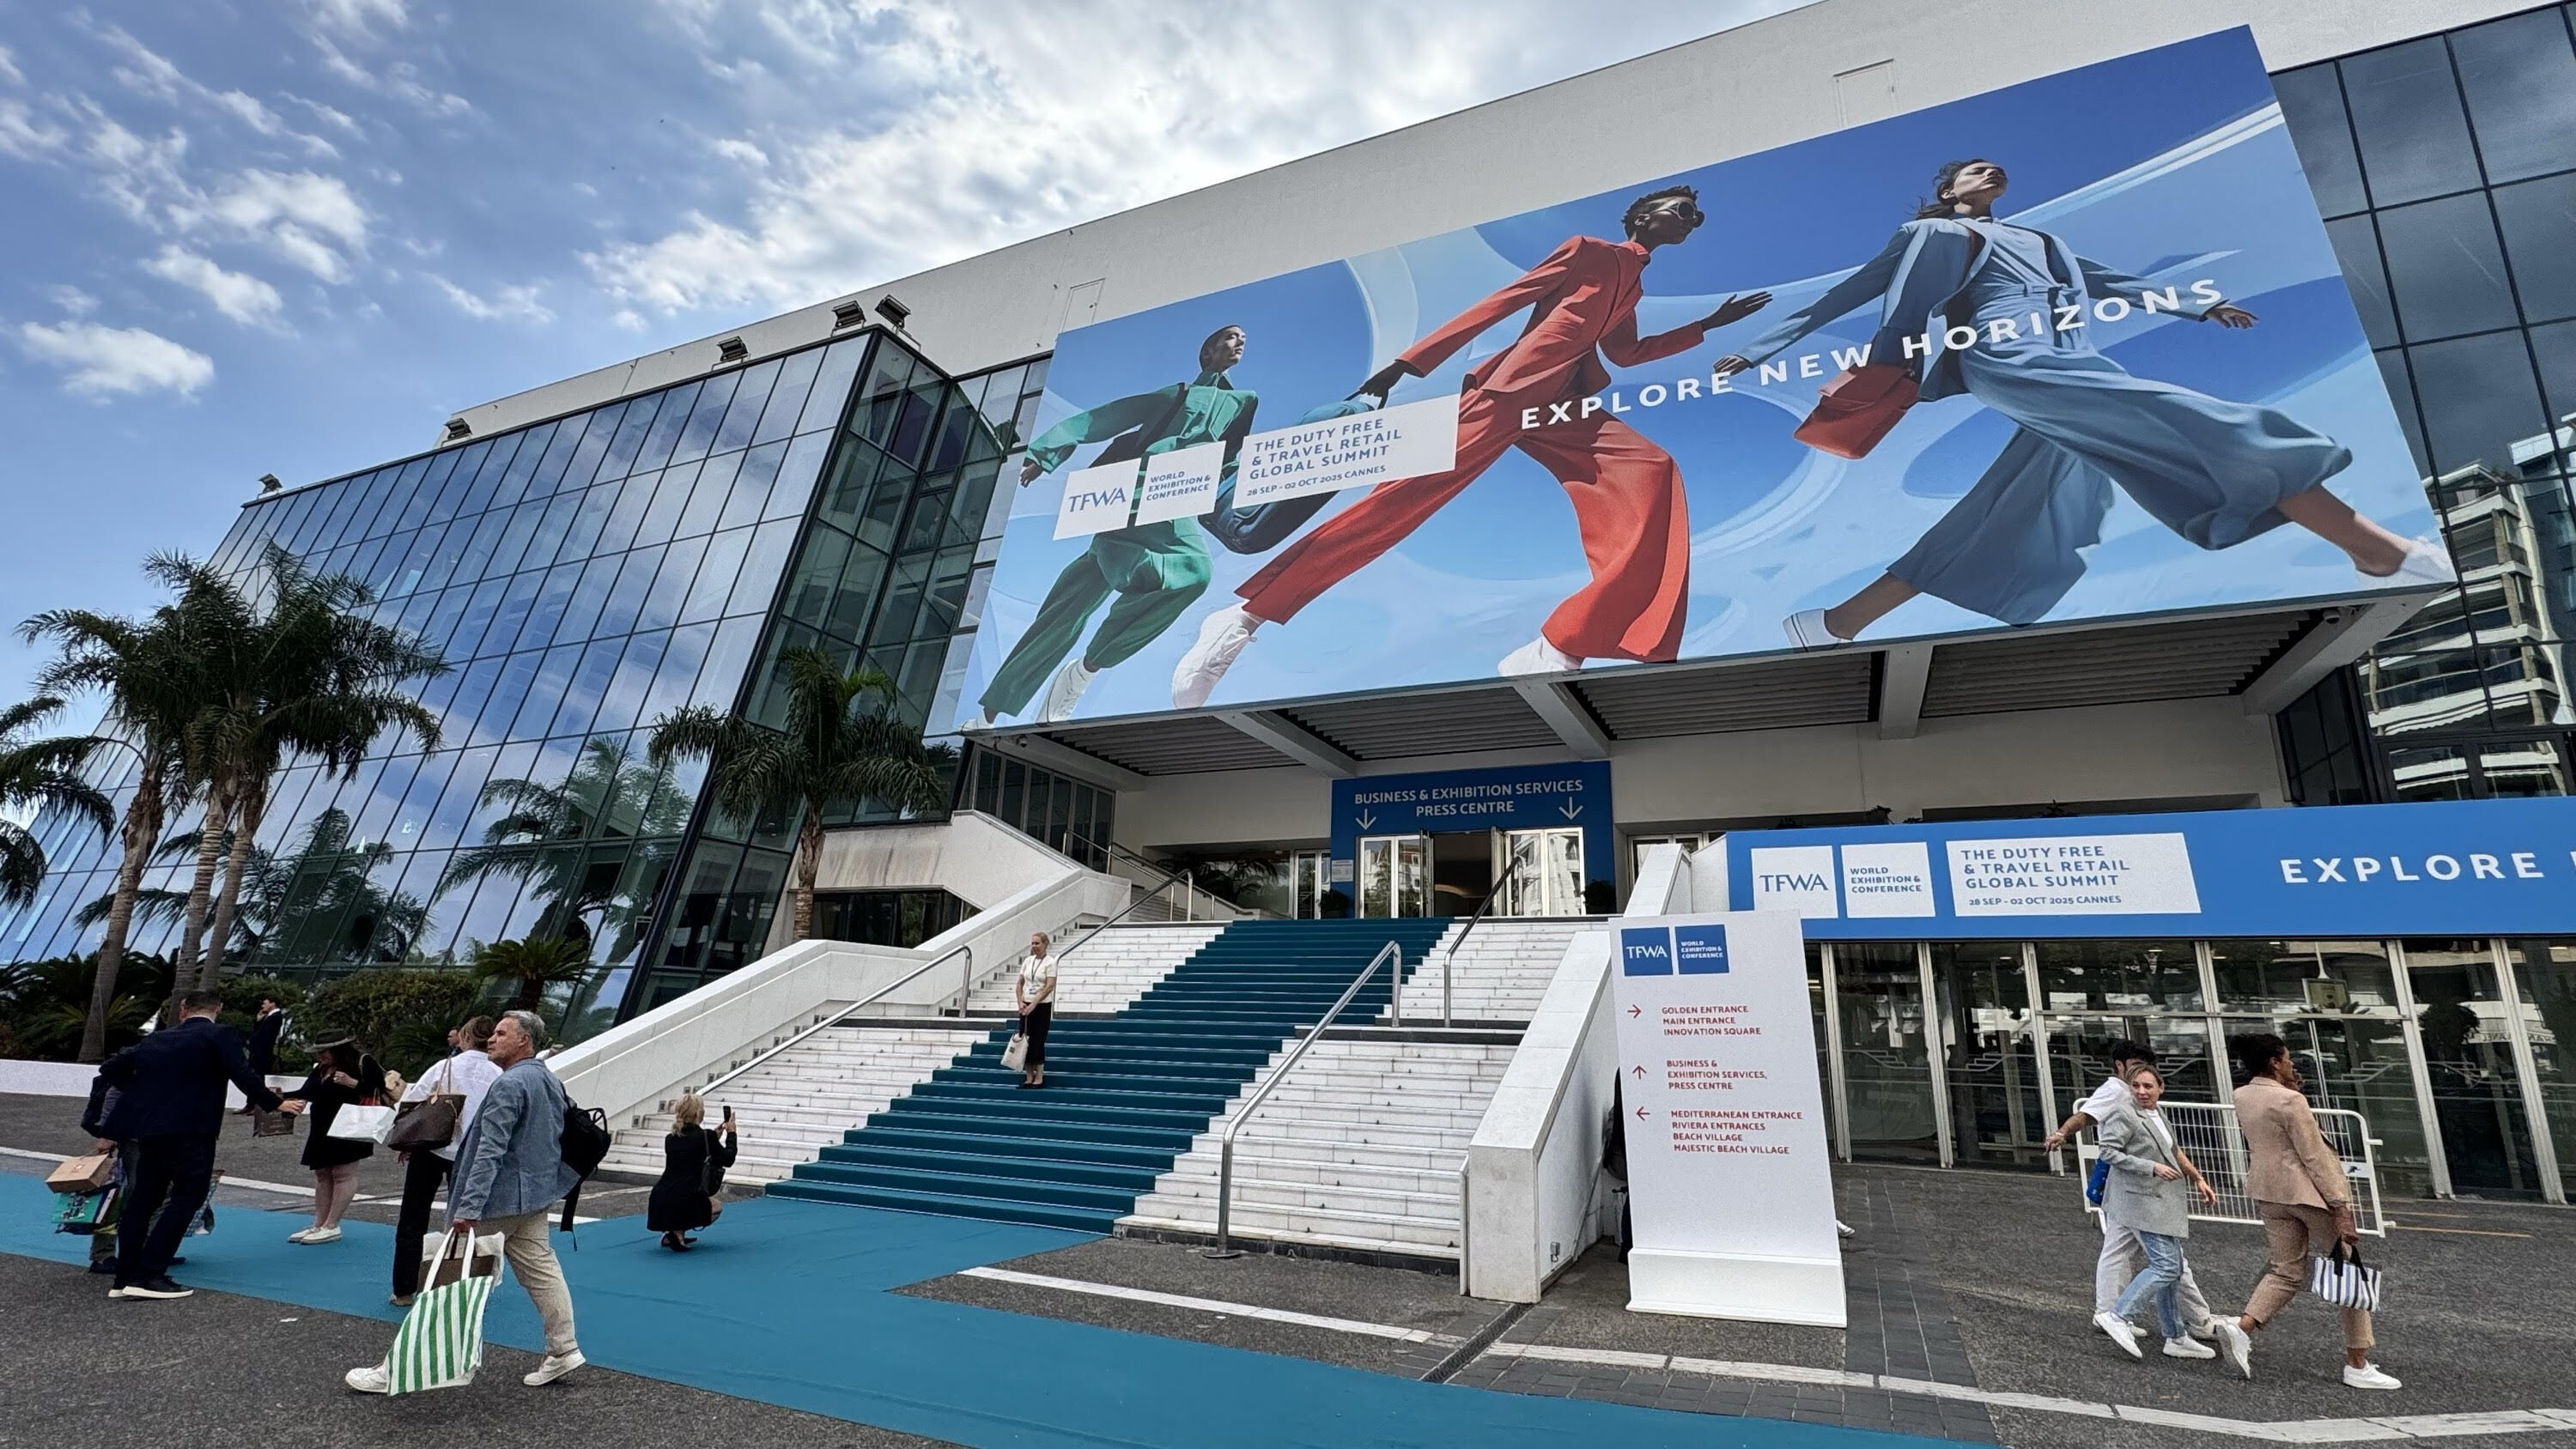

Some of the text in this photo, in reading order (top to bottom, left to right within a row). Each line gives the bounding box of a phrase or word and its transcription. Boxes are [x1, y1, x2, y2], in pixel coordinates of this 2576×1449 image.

[1522, 279, 2221, 429] EXPLORE NEW HORIZONS
[1255, 418, 1383, 452] THE DUTY FREE
[1252, 429, 1402, 466] & TRAVEL RETAIL
[1249, 445, 1389, 480] GLOBAL SUMMIT
[1151, 470, 1185, 483] WORLD
[1260, 485, 1277, 494] SEP
[1298, 477, 1318, 487] OCT
[1320, 474, 1342, 483] 2025
[1344, 464, 1386, 479] CANNES
[1148, 476, 1203, 492] EXHIBITION
[1146, 483, 1209, 501] CONFERENCE
[1069, 488, 1126, 512] TFWA
[1354, 779, 1583, 804] BUSINESS & EXHIBITION SERVICES
[1416, 801, 1515, 816] PRESS CENTRE
[1961, 846, 2105, 860] THE DUTY FREE
[1964, 858, 2130, 875] & TRAVEL RETAIL
[2280, 852, 2545, 883] EXPLORE
[1759, 874, 1829, 894] TFWA
[1850, 875, 1912, 884] EXHIBITION
[1965, 874, 2119, 889] GLOBAL SUMMIT
[1851, 884, 1923, 894] CONFERENCE
[1982, 897, 2002, 906] SEP
[2025, 896, 2046, 905] OCT
[2049, 896, 2075, 905] 2025
[2076, 894, 2122, 905] CANNES
[1626, 945, 1668, 959] TFWA
[1662, 1005, 1748, 1015] GOLDEN ENTRANCE
[1663, 1017, 1685, 1026] MAIN
[1724, 1028, 1761, 1036] SQUARE
[1722, 1071, 1768, 1080] SERVICES,
[1698, 1082, 1733, 1090] CENTRE
[1671, 1110, 1802, 1119] MEDITERRANEAN ENTRANCE
[1710, 1122, 1765, 1131] ENTRANCES
[1673, 1132, 1743, 1142] BEACH VILLAGE
[1674, 1144, 1789, 1154] MAJESTIC BEACH VILLAGE
